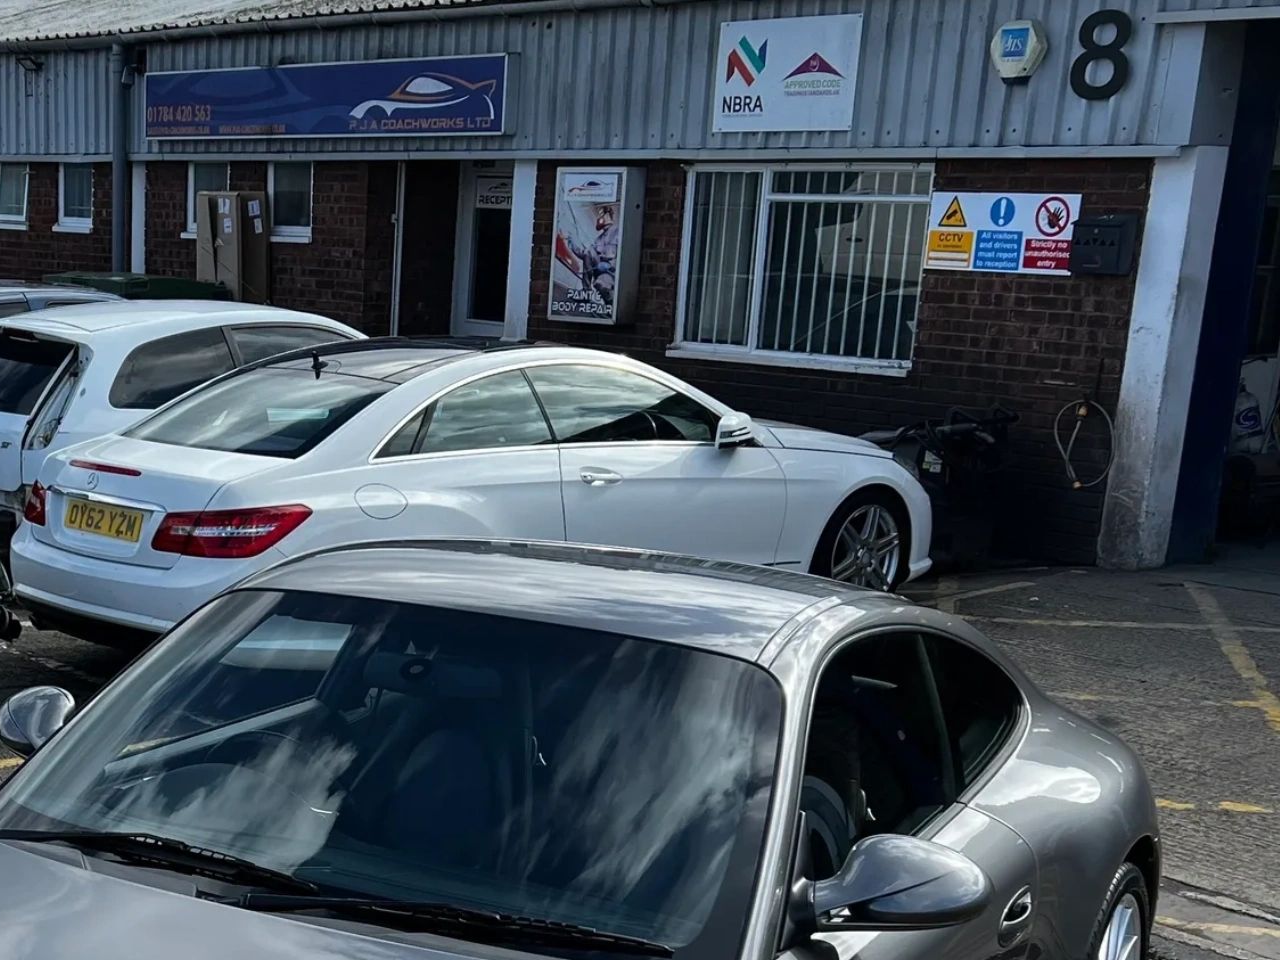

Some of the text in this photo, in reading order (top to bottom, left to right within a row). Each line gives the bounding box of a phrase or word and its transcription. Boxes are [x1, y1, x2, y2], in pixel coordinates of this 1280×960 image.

[1070, 9, 1132, 100] 8
[784, 79, 841, 89] APPROVED CODE
[722, 95, 763, 113] NBRA
[147, 105, 211, 122] 01784 420 563
[380, 118, 464, 129] COACHWORKS
[467, 117, 491, 129] LTD
[939, 232, 963, 242] CCTV
[981, 231, 1018, 240] All visitors
[979, 241, 1018, 250] and drivers
[1030, 240, 1068, 249] Strictly no
[978, 250, 1018, 260] must report
[976, 259, 1017, 269] to reception
[1036, 260, 1056, 269] entry
[567, 289, 593, 299] PAINT
[552, 301, 613, 314] BODY REPAIR
[108, 510, 138, 537] YZM
